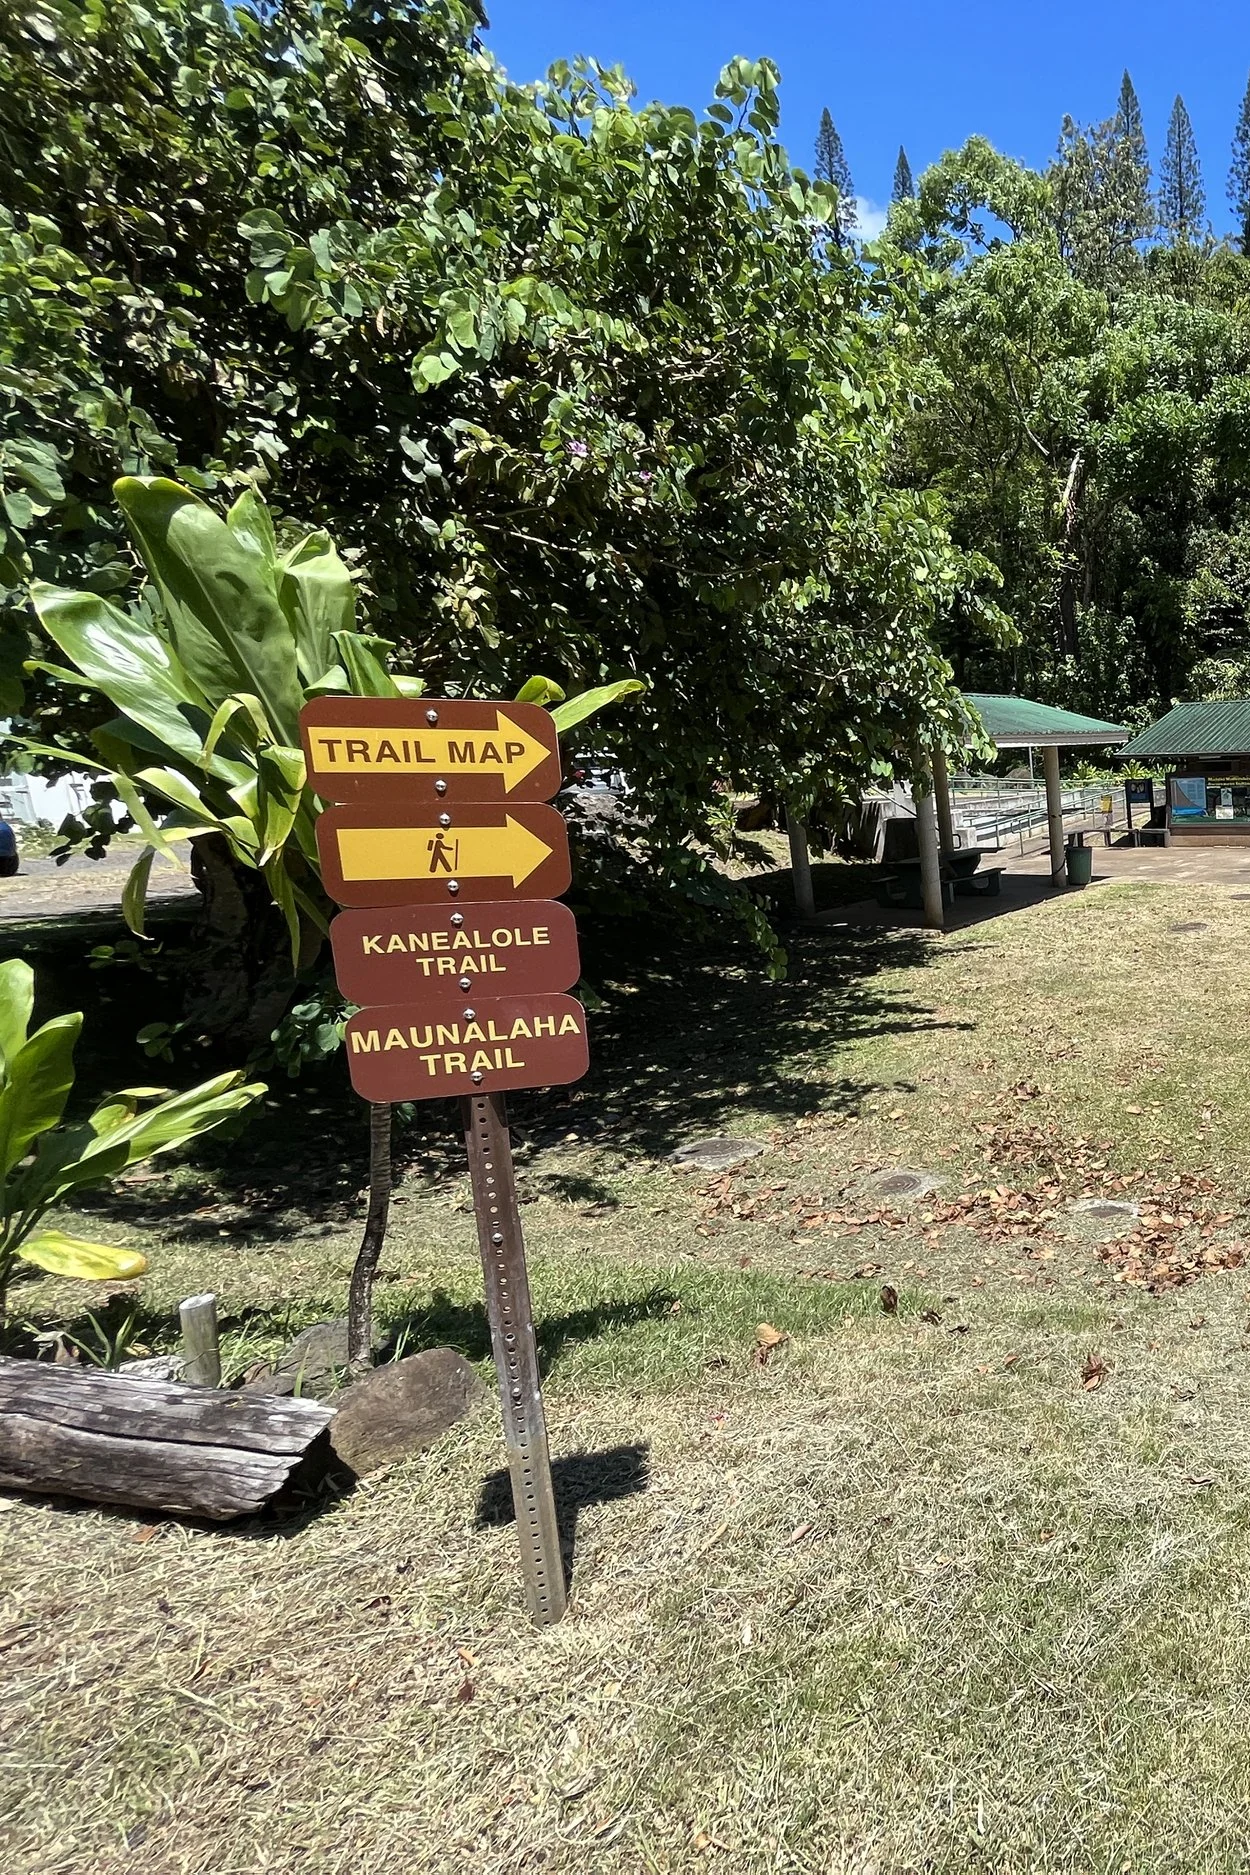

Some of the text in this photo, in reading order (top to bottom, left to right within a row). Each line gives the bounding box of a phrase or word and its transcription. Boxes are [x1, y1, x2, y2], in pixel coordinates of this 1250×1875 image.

[318, 739, 525, 764] TRAIL MAP
[362, 926, 550, 955] KANEALOLE
[416, 954, 506, 977] TRAIL
[351, 1014, 580, 1054] MAUNALAHA
[420, 1048, 525, 1076] TRAIL
